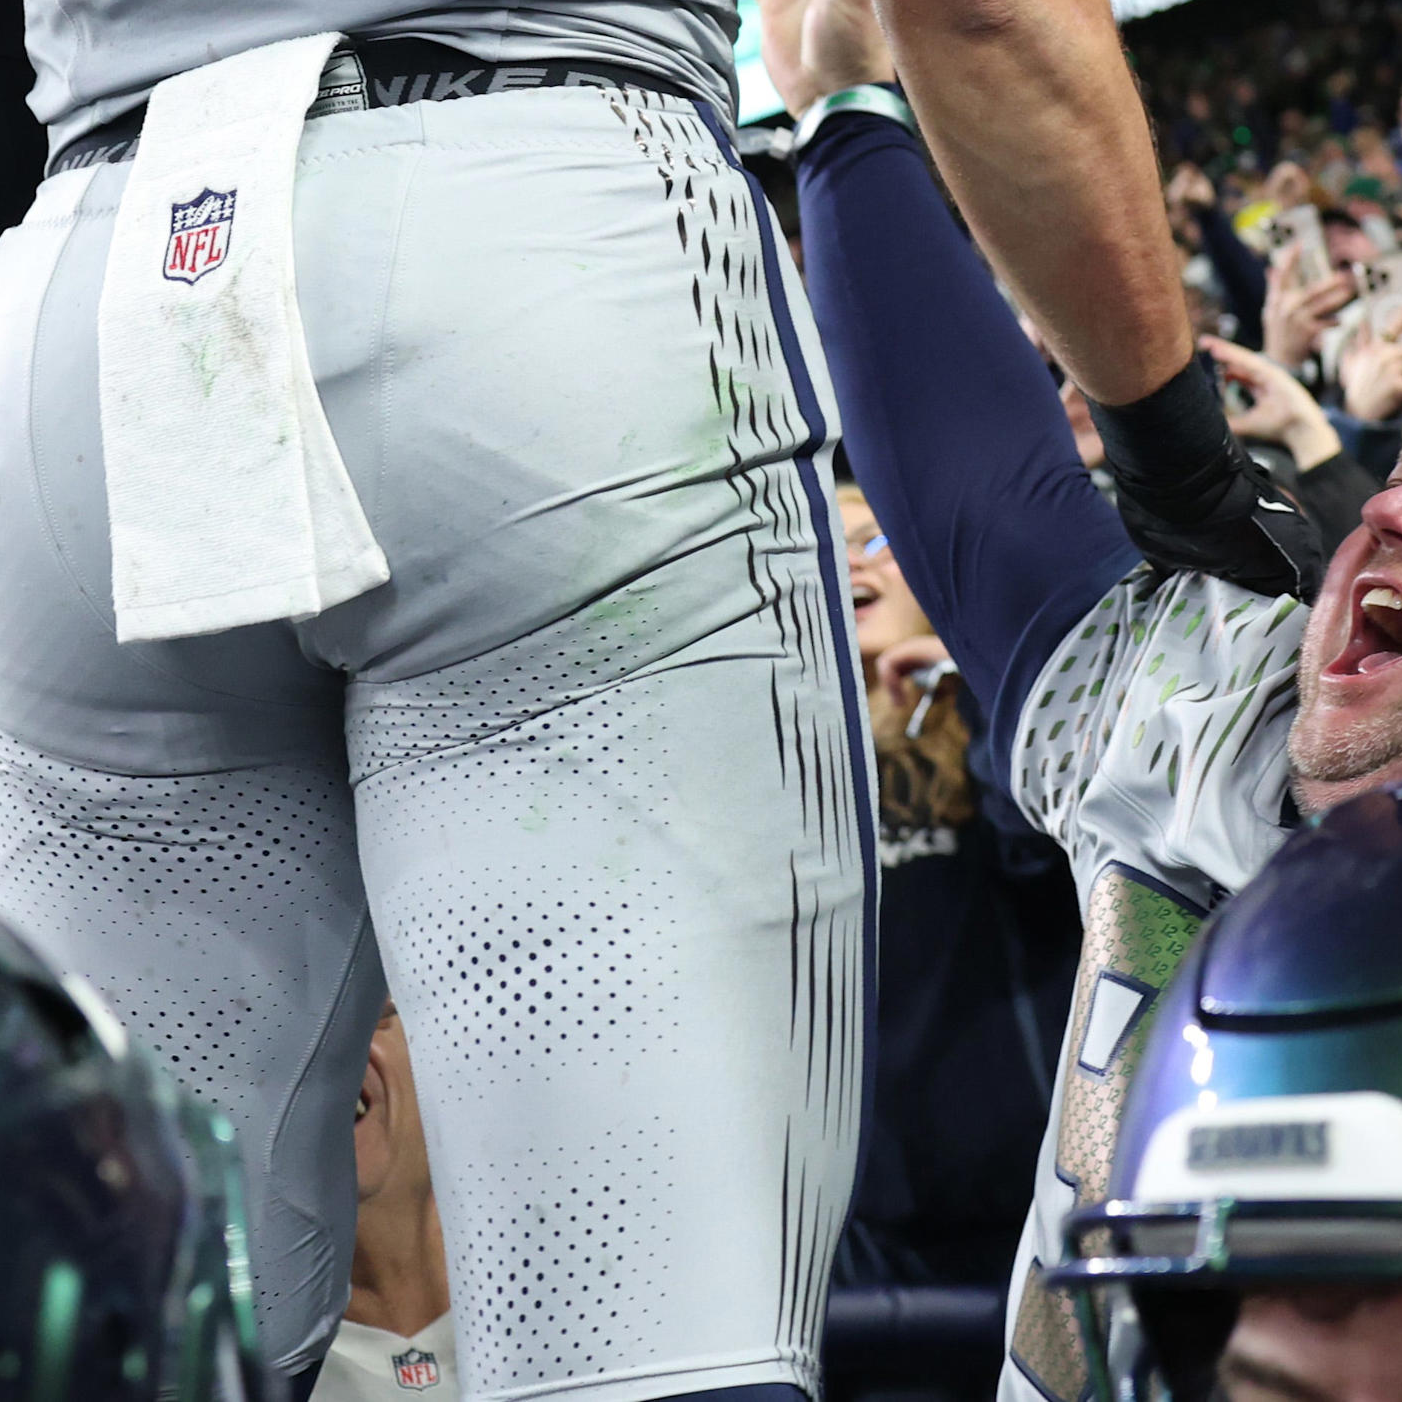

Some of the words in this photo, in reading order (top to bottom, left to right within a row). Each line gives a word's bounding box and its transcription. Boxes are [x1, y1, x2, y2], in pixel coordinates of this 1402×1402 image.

[330, 84, 361, 96] PRO
[169, 224, 222, 273] NFL
[399, 1361, 437, 1386] NFL
